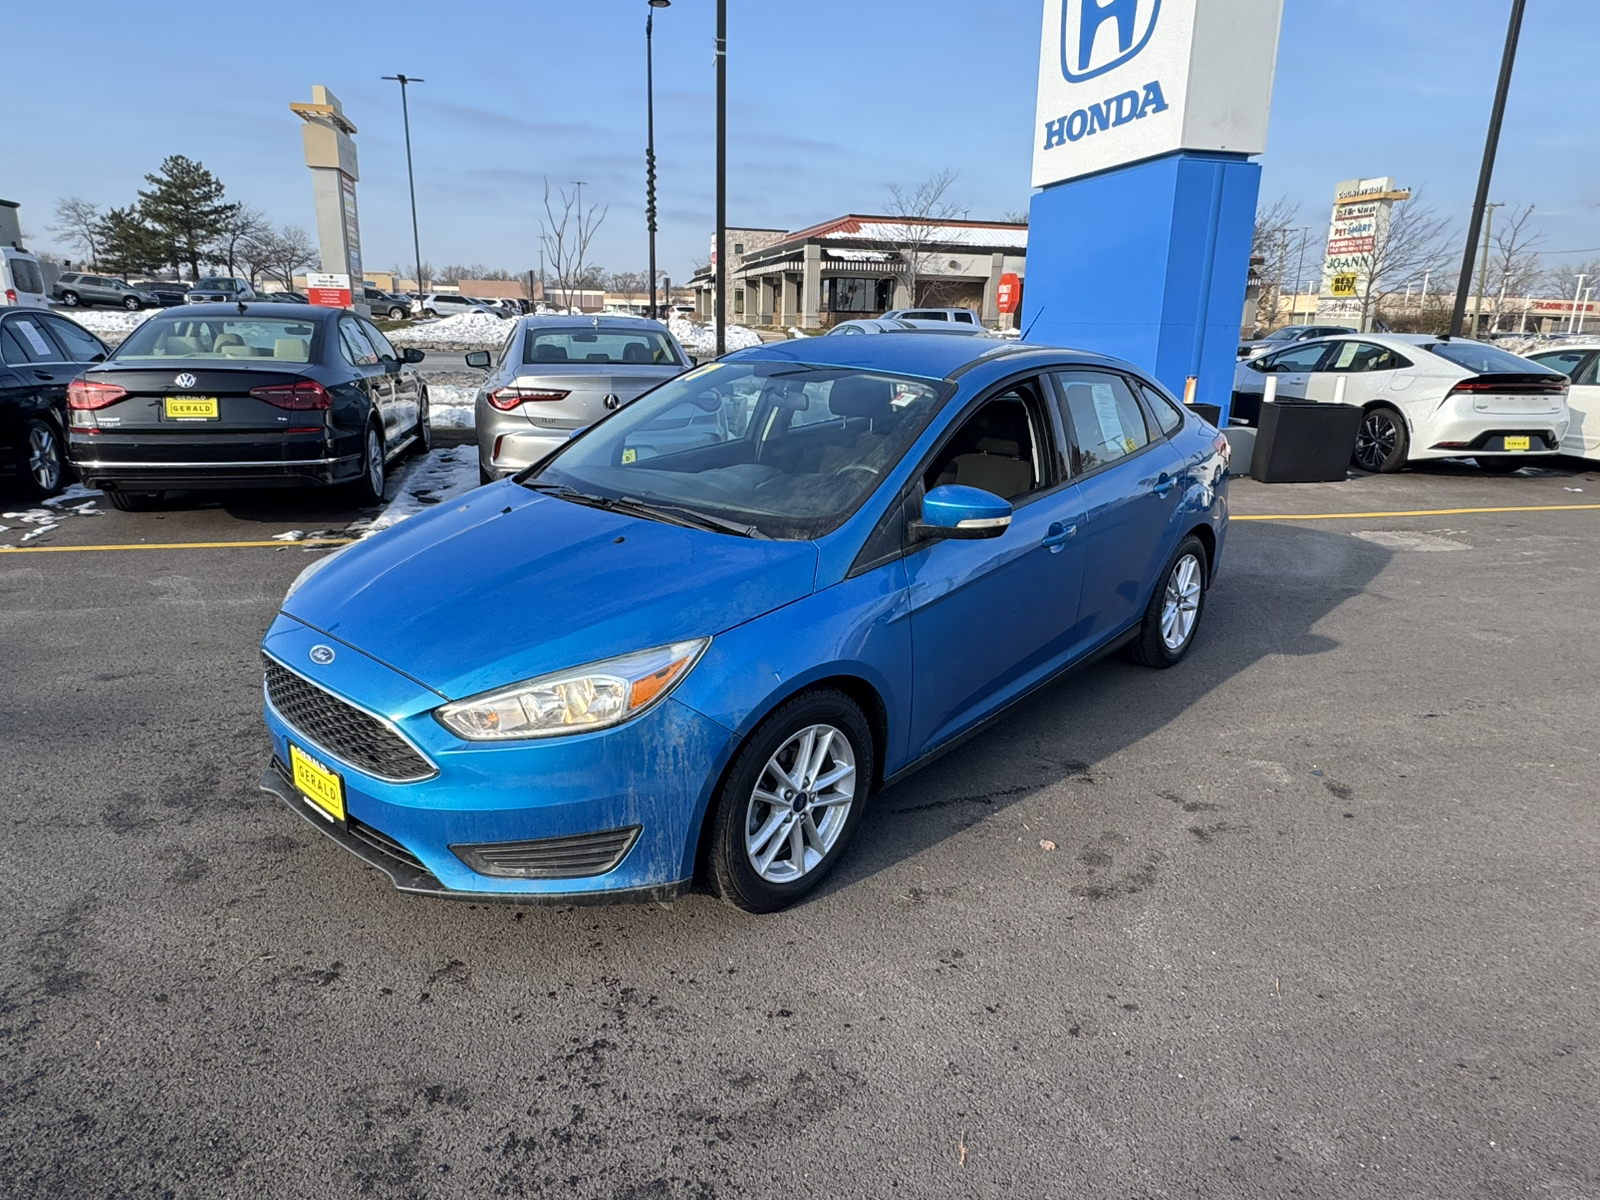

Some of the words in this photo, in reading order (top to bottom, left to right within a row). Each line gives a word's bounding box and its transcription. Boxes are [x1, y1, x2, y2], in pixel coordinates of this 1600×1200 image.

[1043, 80, 1169, 150] HONDA
[1338, 185, 1384, 199] COUNTRYSIDE
[1334, 276, 1356, 284] BEST
[1535, 302, 1561, 310] FLOOR
[172, 404, 211, 412] GERALD
[299, 765, 336, 801] GERALD
